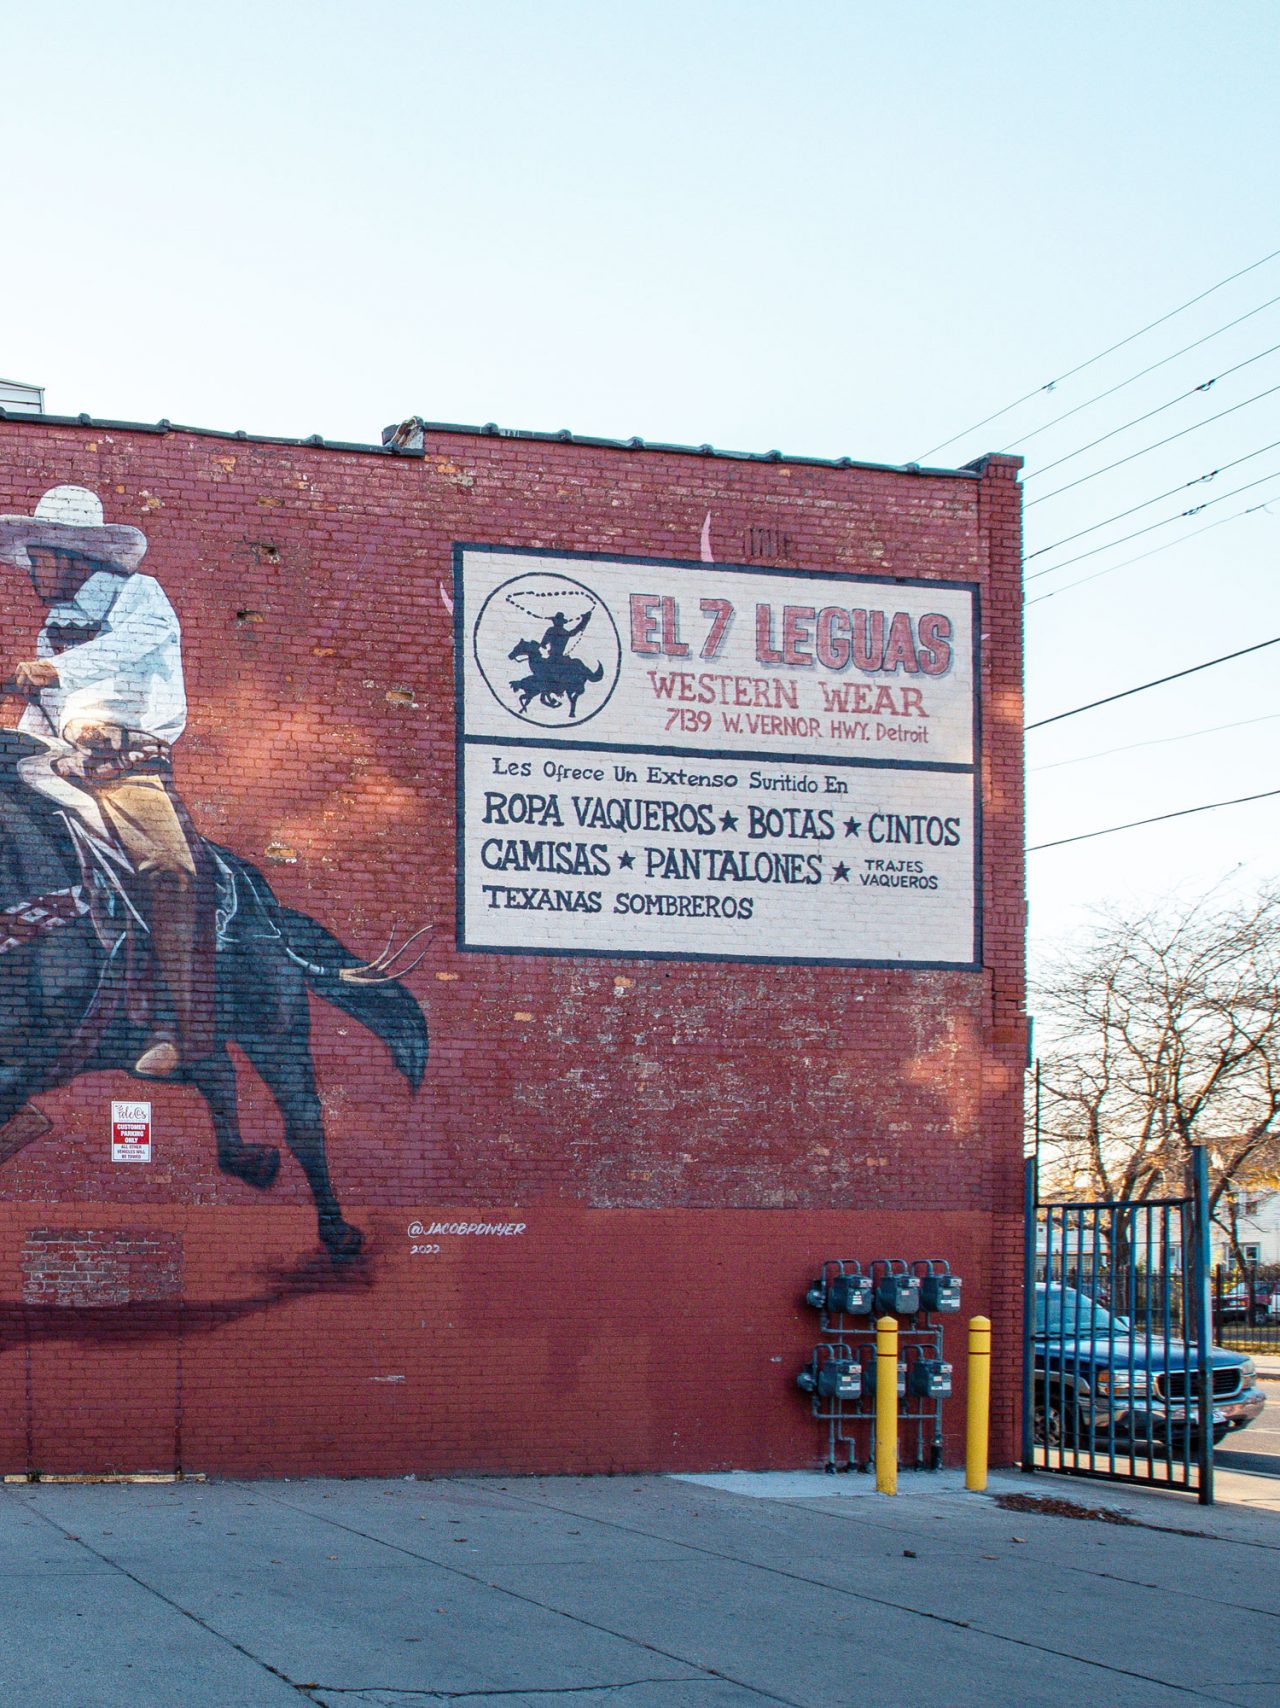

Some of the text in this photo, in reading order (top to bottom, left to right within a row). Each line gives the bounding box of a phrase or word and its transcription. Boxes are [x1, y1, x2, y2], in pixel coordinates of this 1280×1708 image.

[629, 593, 952, 676] EL 7 LEGUAS
[647, 670, 930, 718] WESTERN WEAR
[664, 708, 712, 733] 7139
[831, 720, 870, 741] HWY.
[876, 722, 929, 744] Detroit
[492, 757, 849, 794] Les Ofrece Un Extenso Suritido En
[481, 791, 961, 846] ROPA VAQUEROS BOTAS CINTOS
[480, 838, 823, 885] CAMISAS PANTALONES
[864, 859, 924, 874] TRAJES
[860, 873, 939, 890] VAQUEROS
[482, 885, 754, 920] TEXANAS SOMBREROS
[407, 1220, 527, 1239] @JACOBPDWYER
